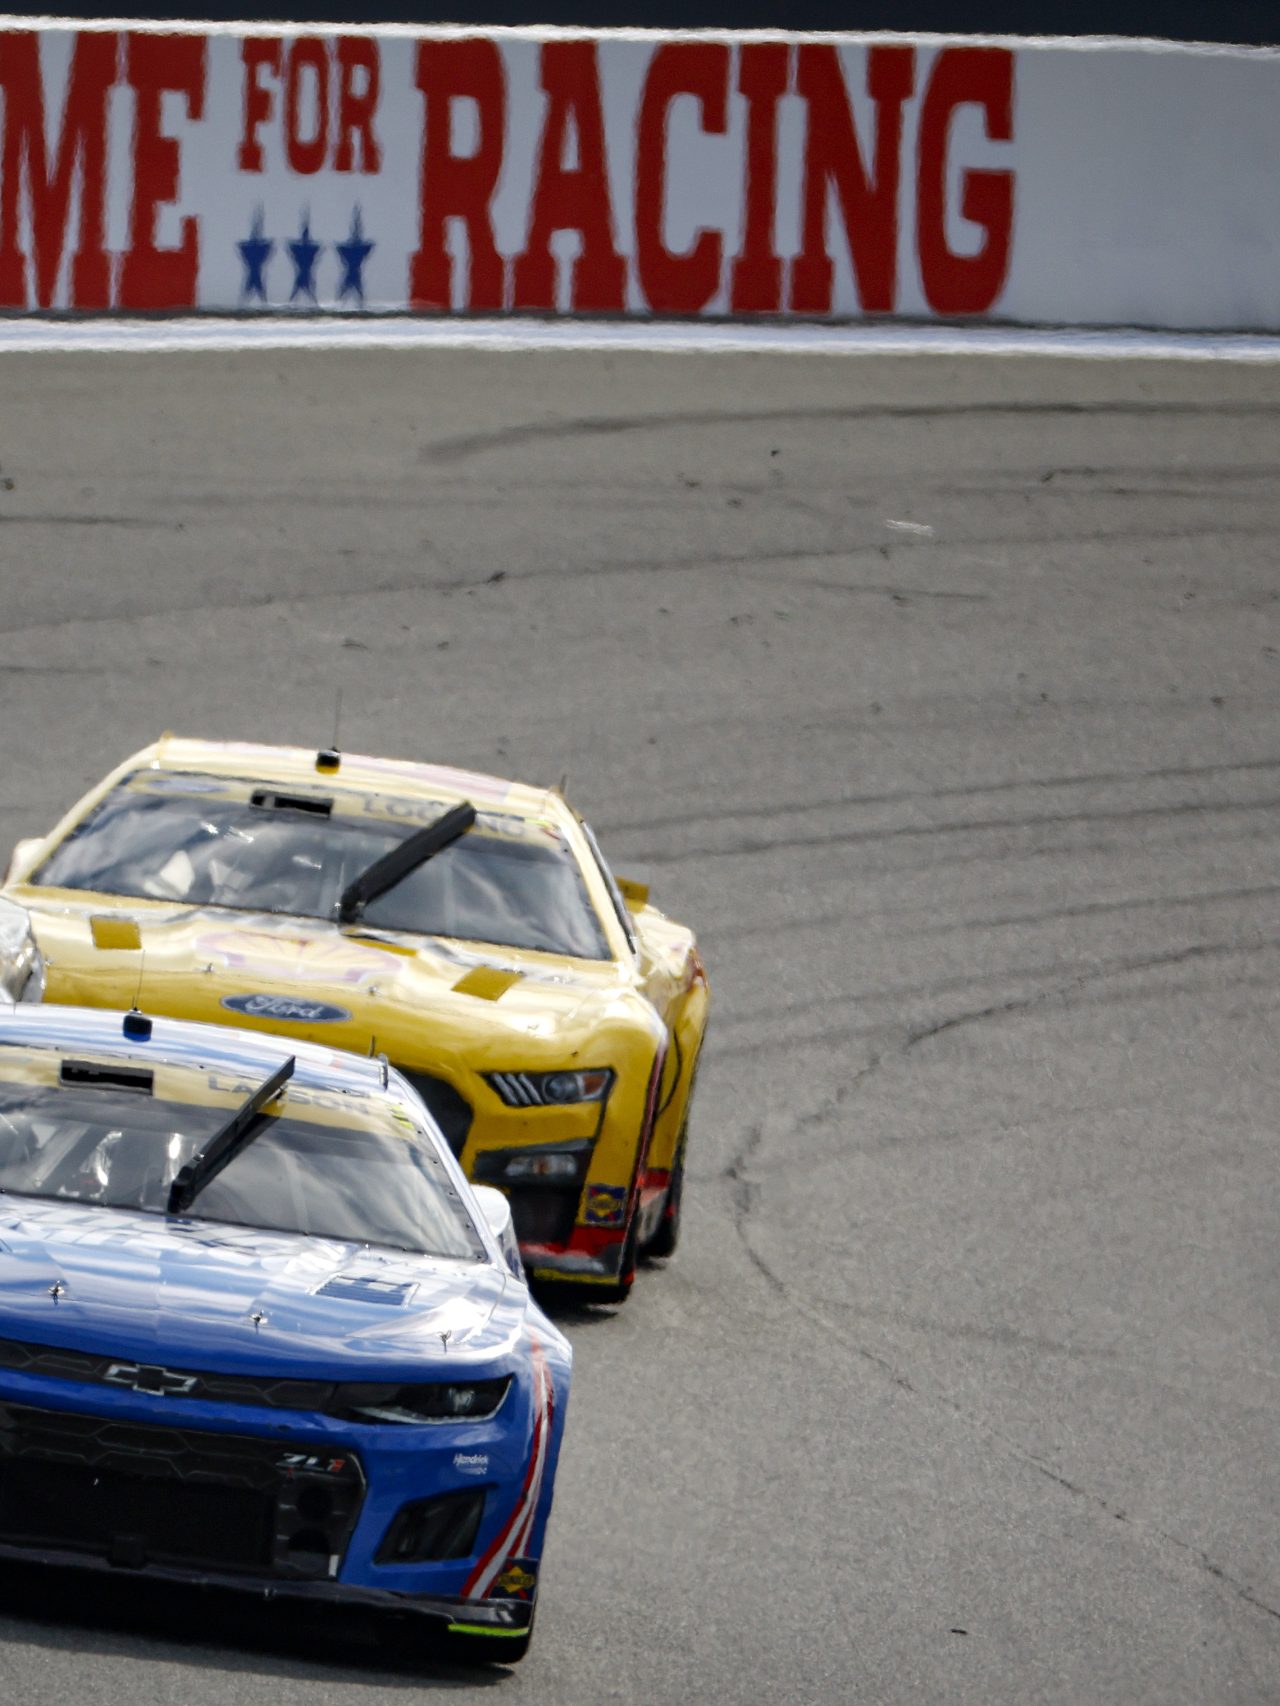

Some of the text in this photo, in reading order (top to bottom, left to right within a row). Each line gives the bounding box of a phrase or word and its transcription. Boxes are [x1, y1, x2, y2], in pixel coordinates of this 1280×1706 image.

[237, 34, 381, 175] FOR
[408, 37, 1015, 317] RACING
[245, 996, 324, 1019] Ford
[208, 1075, 370, 1115] LASON
